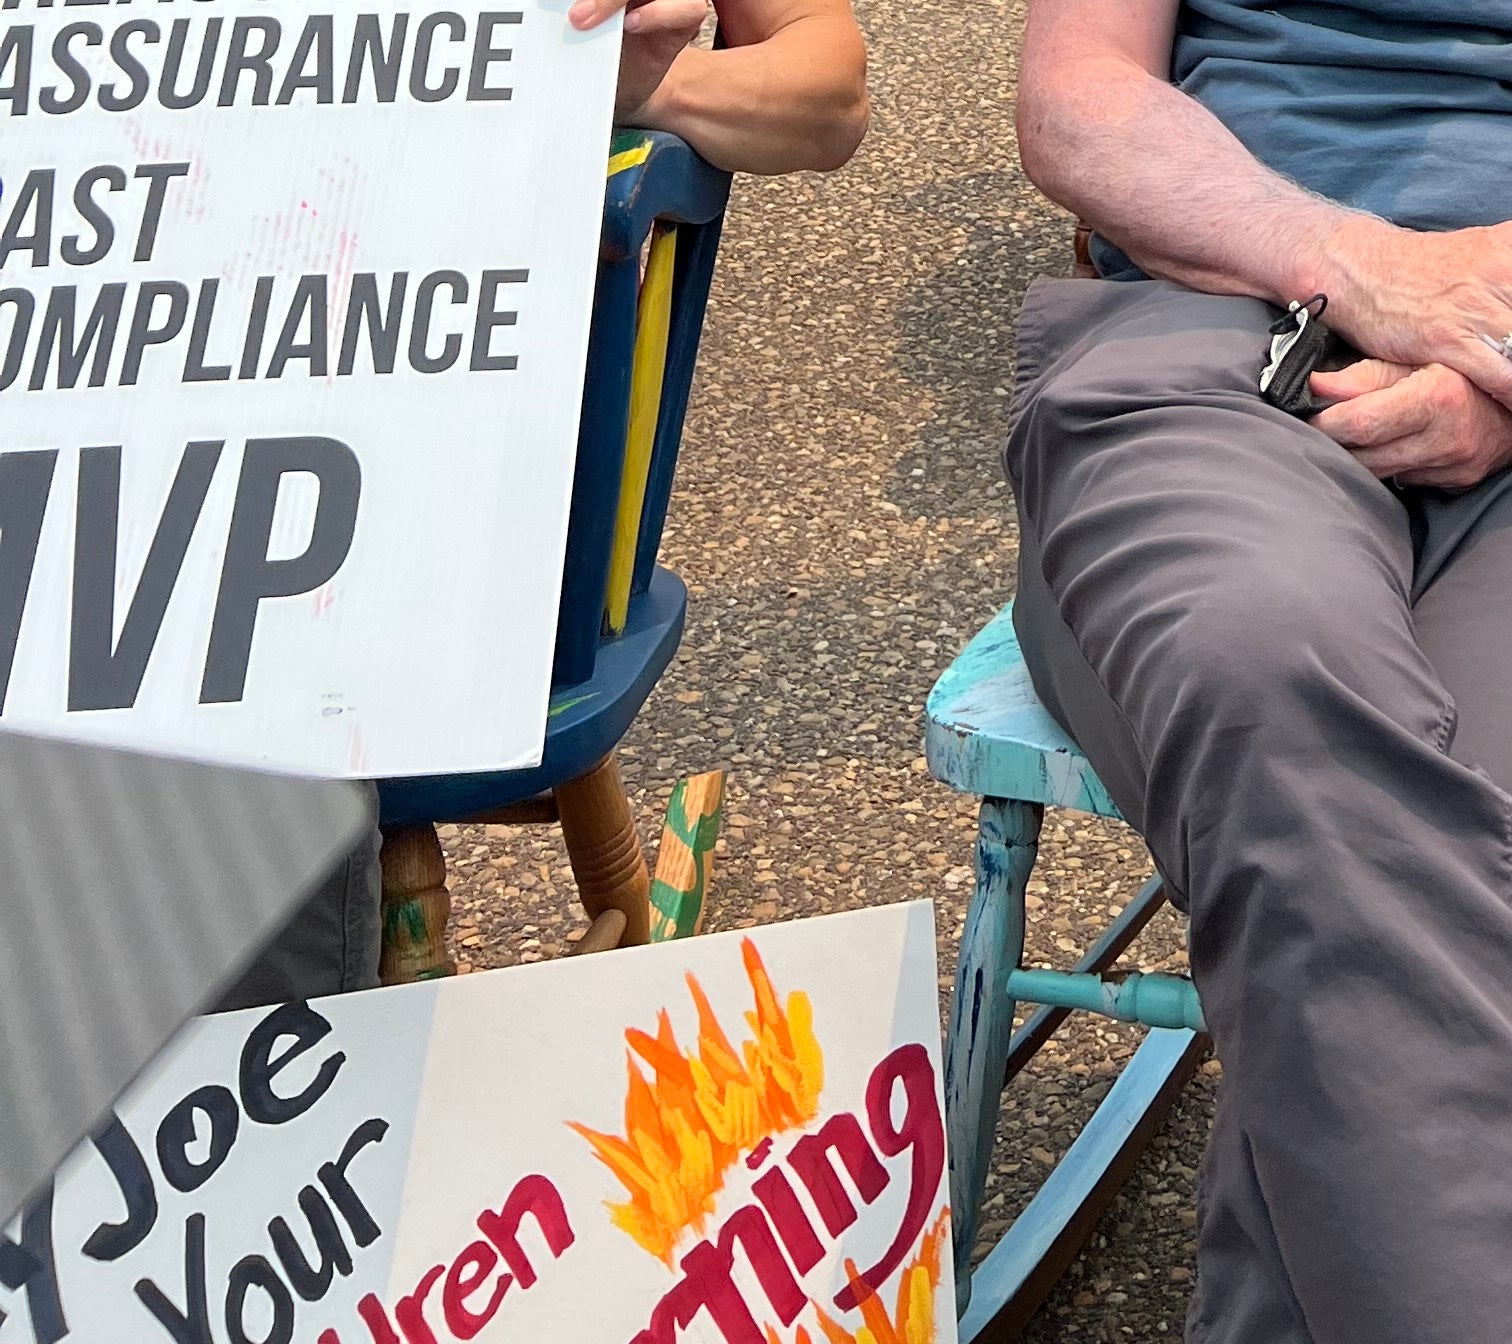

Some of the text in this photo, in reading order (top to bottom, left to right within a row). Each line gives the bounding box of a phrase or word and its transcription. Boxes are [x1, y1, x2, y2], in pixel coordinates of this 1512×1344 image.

[0, 12, 523, 116] ASSURANCE
[0, 162, 190, 268] AST
[81, 999, 346, 1262] Joe
[134, 1118, 389, 1344] Your
